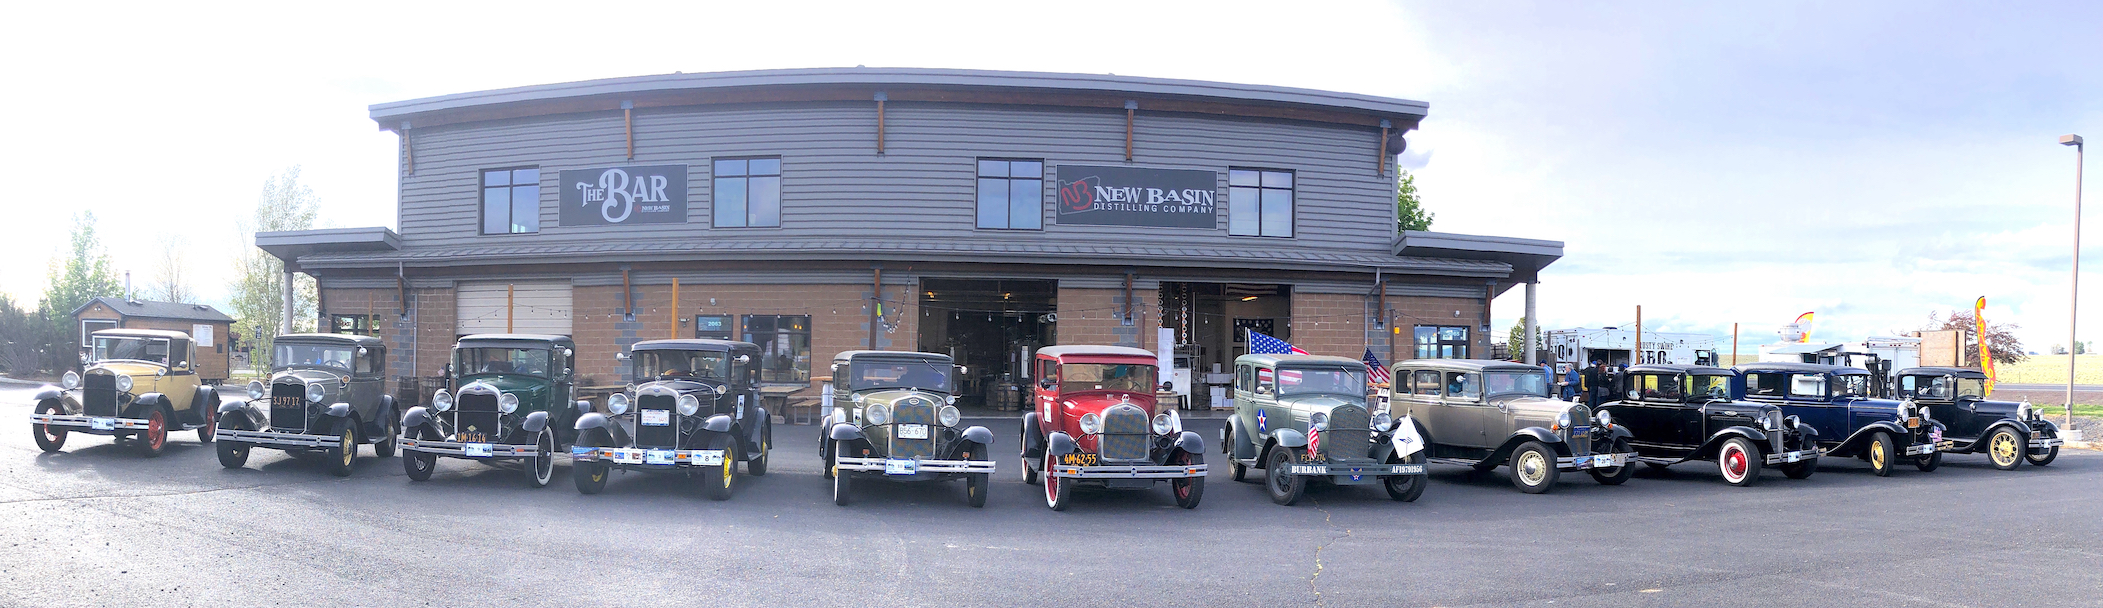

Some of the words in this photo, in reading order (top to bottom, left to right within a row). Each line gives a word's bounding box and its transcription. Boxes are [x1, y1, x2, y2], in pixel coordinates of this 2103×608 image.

[576, 182, 605, 207] THE
[599, 168, 670, 223] BAR
[1094, 186, 1142, 204] NEW
[1146, 188, 1215, 206] BASIN
[1094, 203, 1158, 213] DISTILLING
[1164, 205, 1214, 214] COMPANY
[1291, 465, 1327, 474] BURBANK
